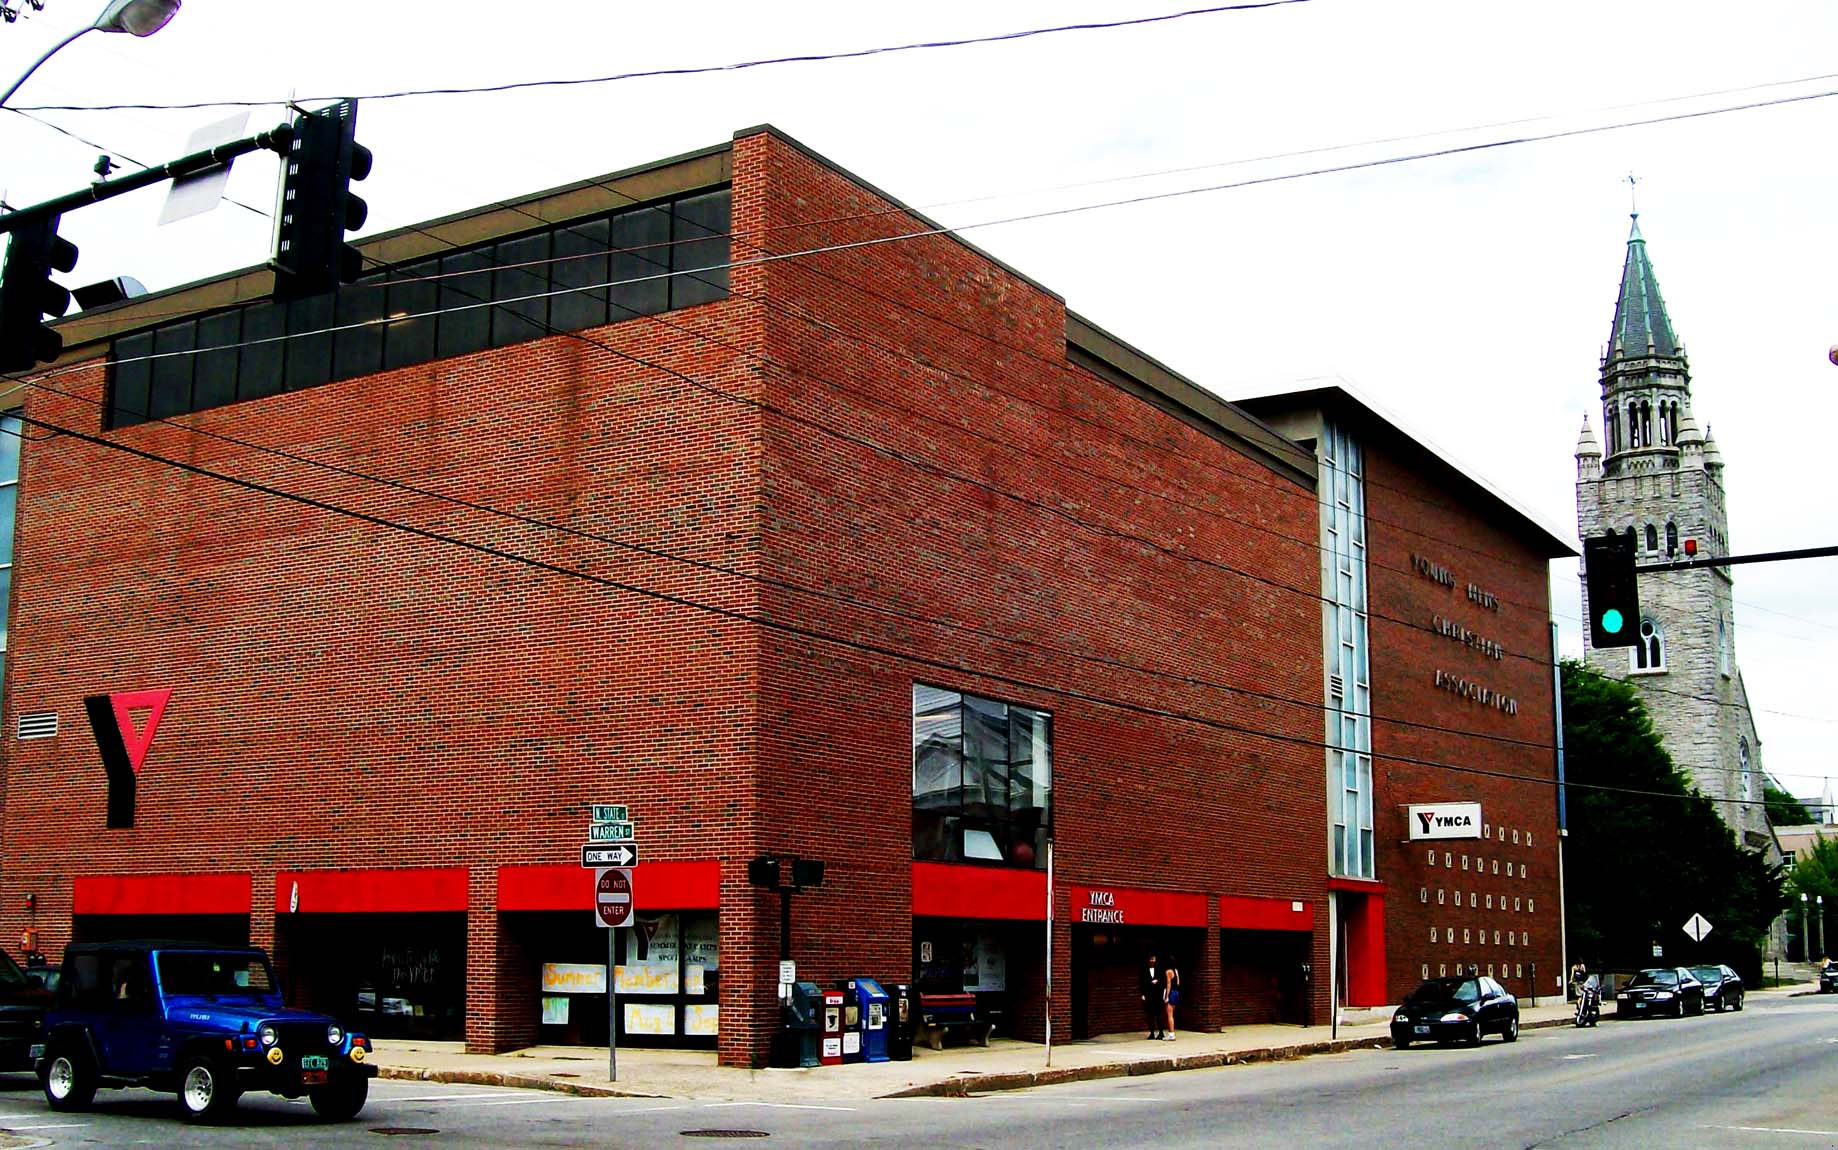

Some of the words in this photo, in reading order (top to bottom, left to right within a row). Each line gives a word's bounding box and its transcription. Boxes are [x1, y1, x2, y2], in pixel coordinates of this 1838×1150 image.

[1433, 614, 1504, 660] CHRISTIAN
[1435, 669, 1518, 715] ASSOCIATION
[603, 807, 620, 820] STATE
[1435, 816, 1472, 827] YMCA
[592, 825, 624, 839] WARREN
[587, 852, 602, 861] ONE
[607, 852, 623, 861] WAY
[600, 880, 610, 889] DO
[613, 880, 626, 889] NOT
[1089, 891, 1115, 906] YMCA
[603, 906, 625, 915] ENTER
[1081, 908, 1124, 924] ENTRANCE
[543, 963, 601, 986] Summer
